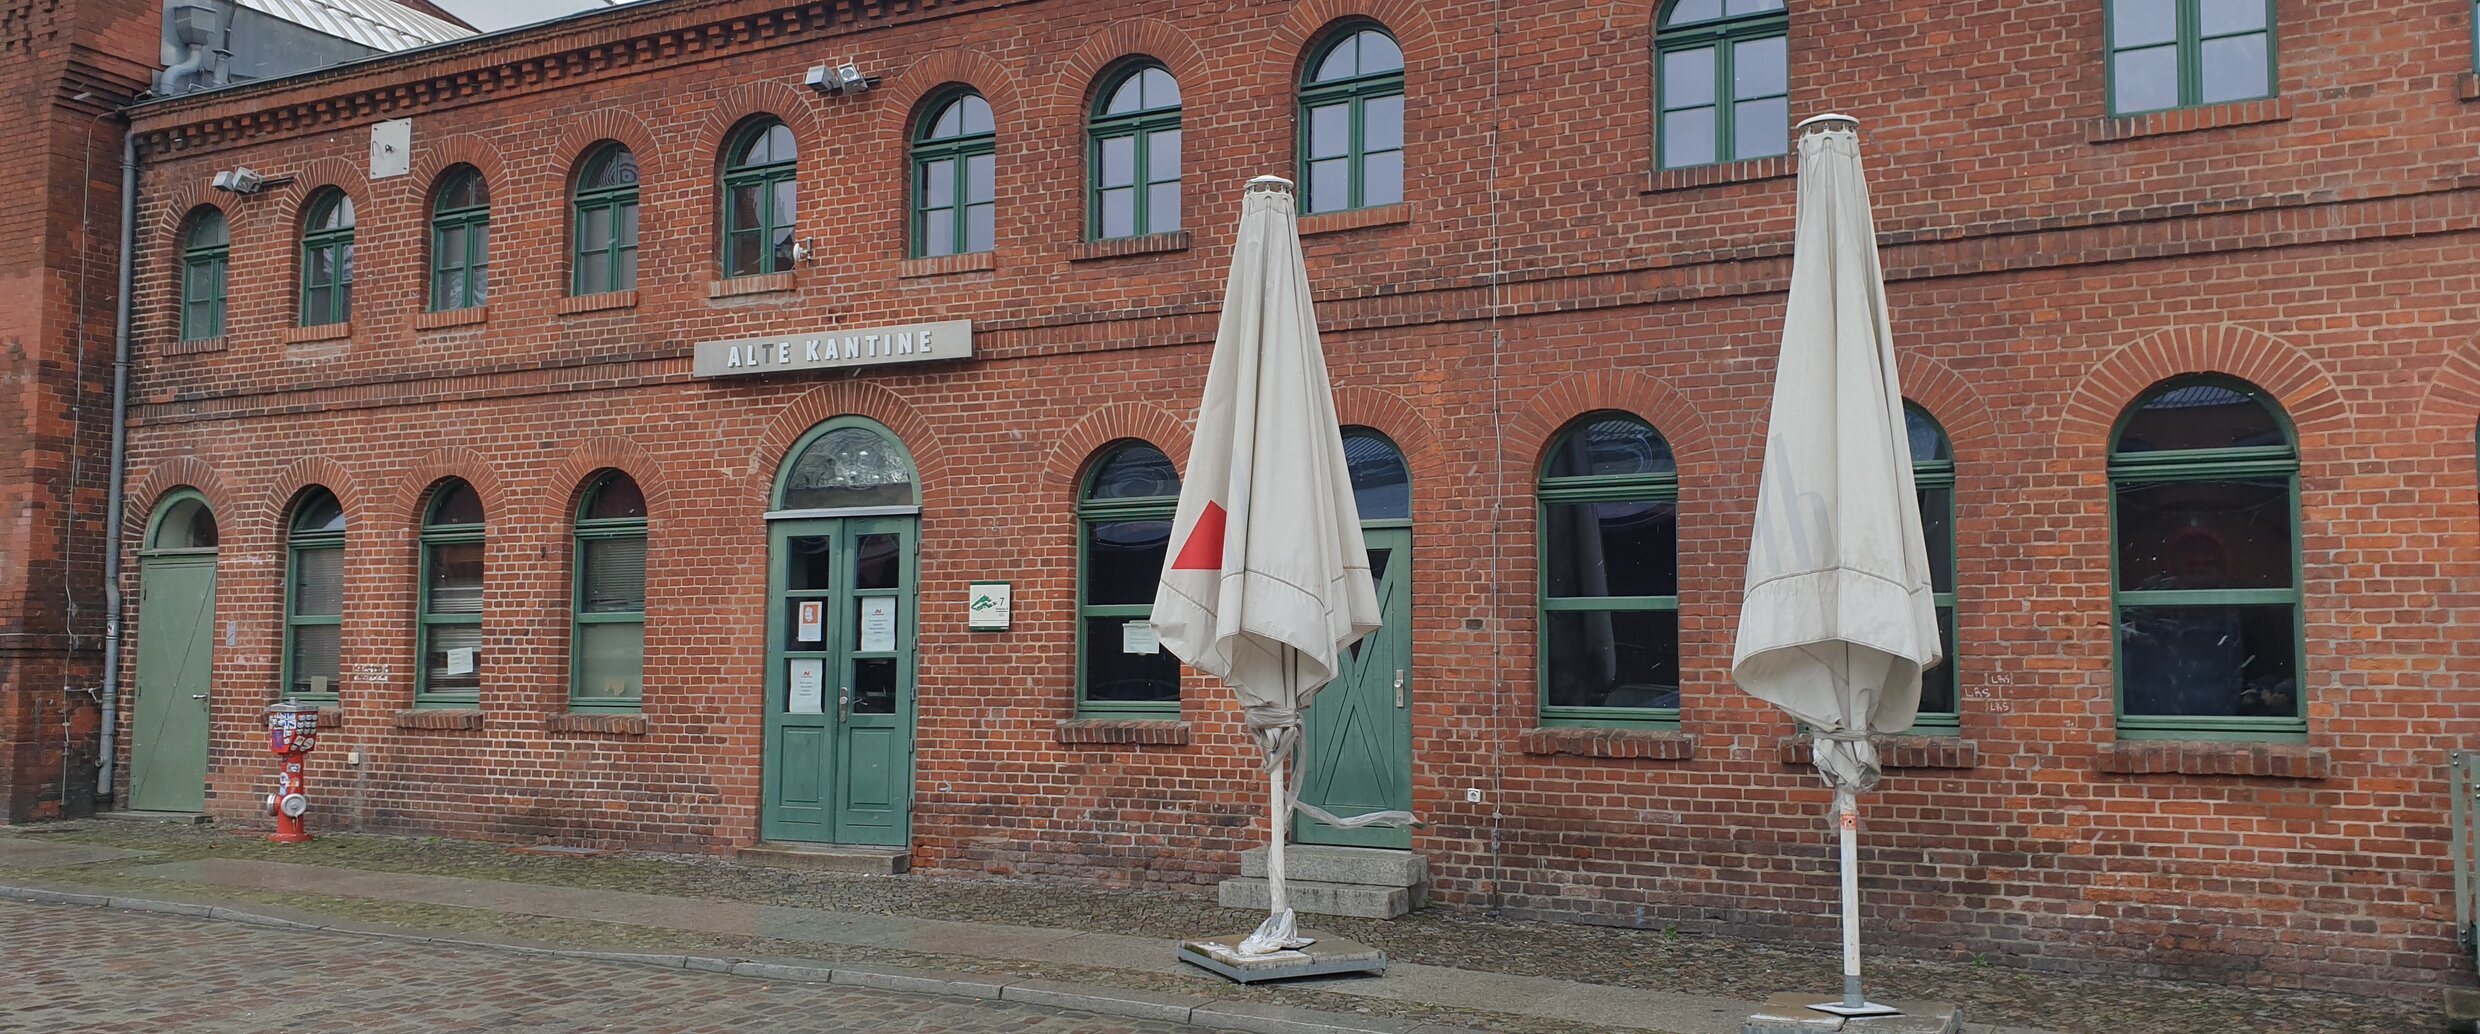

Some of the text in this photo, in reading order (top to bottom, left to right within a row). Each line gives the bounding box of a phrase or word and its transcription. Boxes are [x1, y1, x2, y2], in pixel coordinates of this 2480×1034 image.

[727, 330, 932, 368] ALTE KANTINE
[999, 596, 1005, 607] 7
